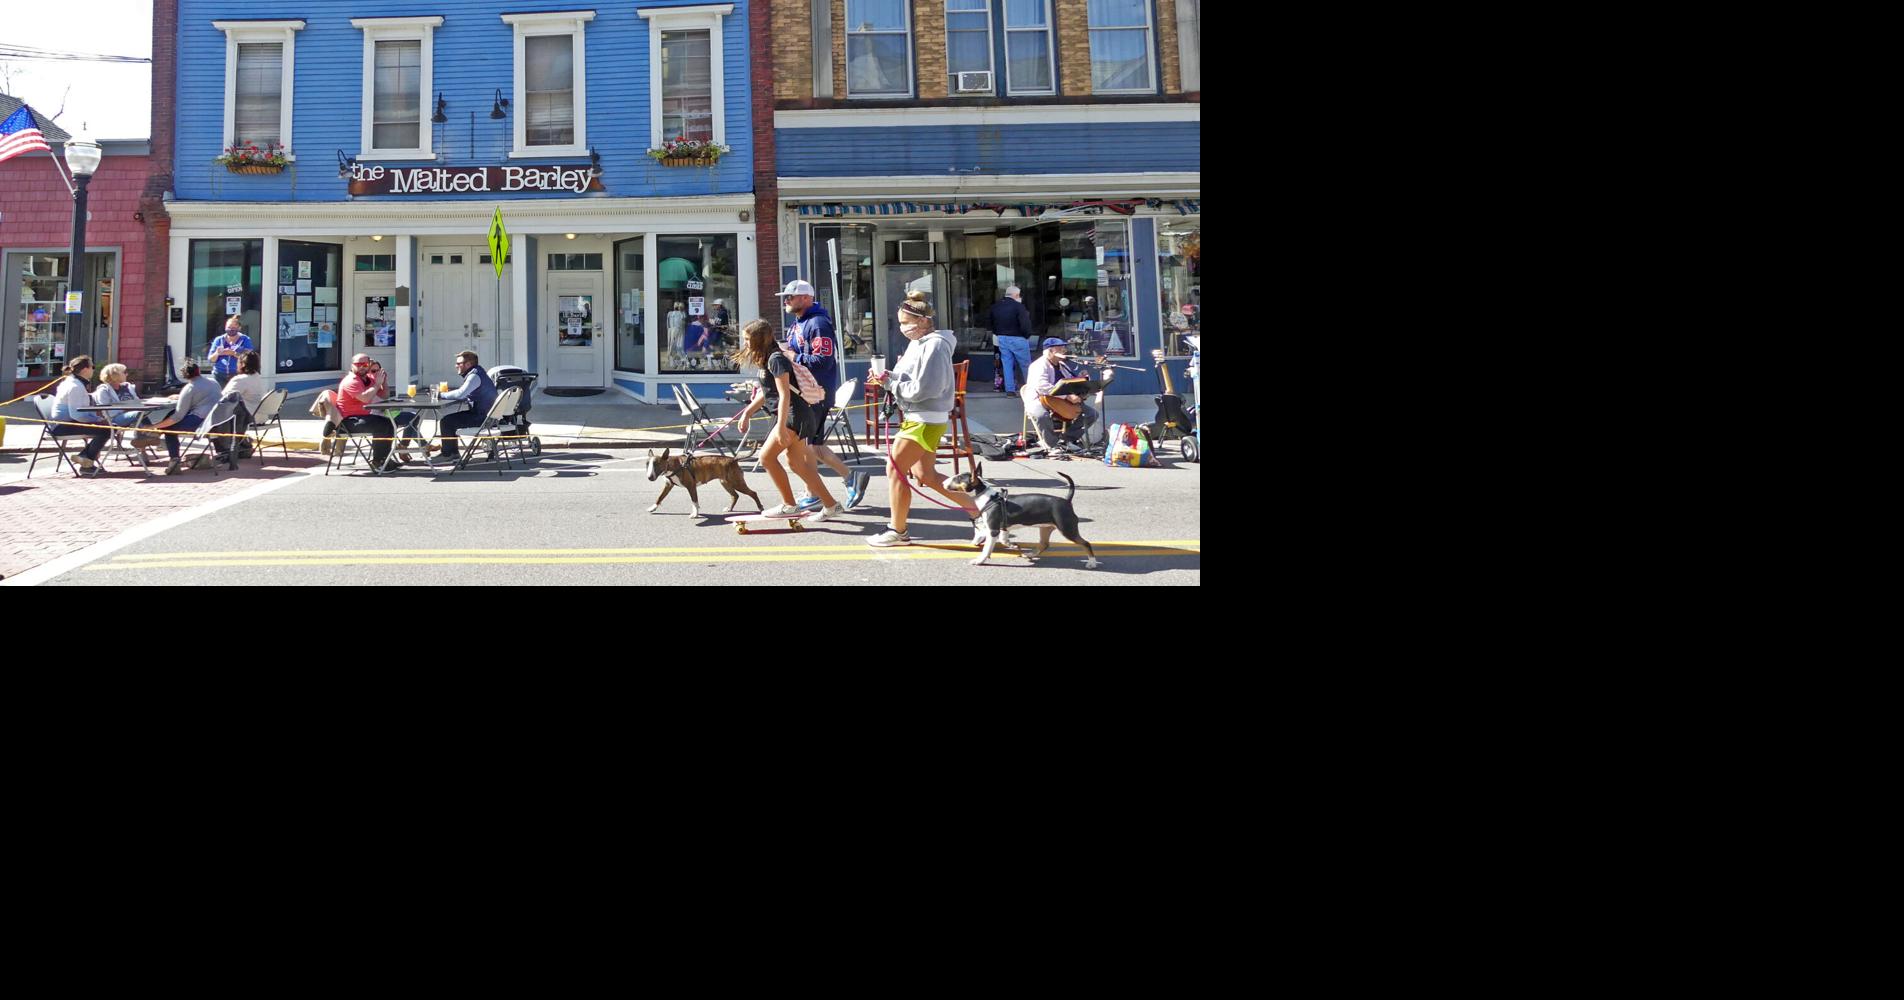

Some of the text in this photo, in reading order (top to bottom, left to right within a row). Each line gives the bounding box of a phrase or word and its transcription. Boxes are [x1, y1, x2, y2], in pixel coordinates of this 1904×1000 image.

[351, 163, 593, 193] the Malted Barley
